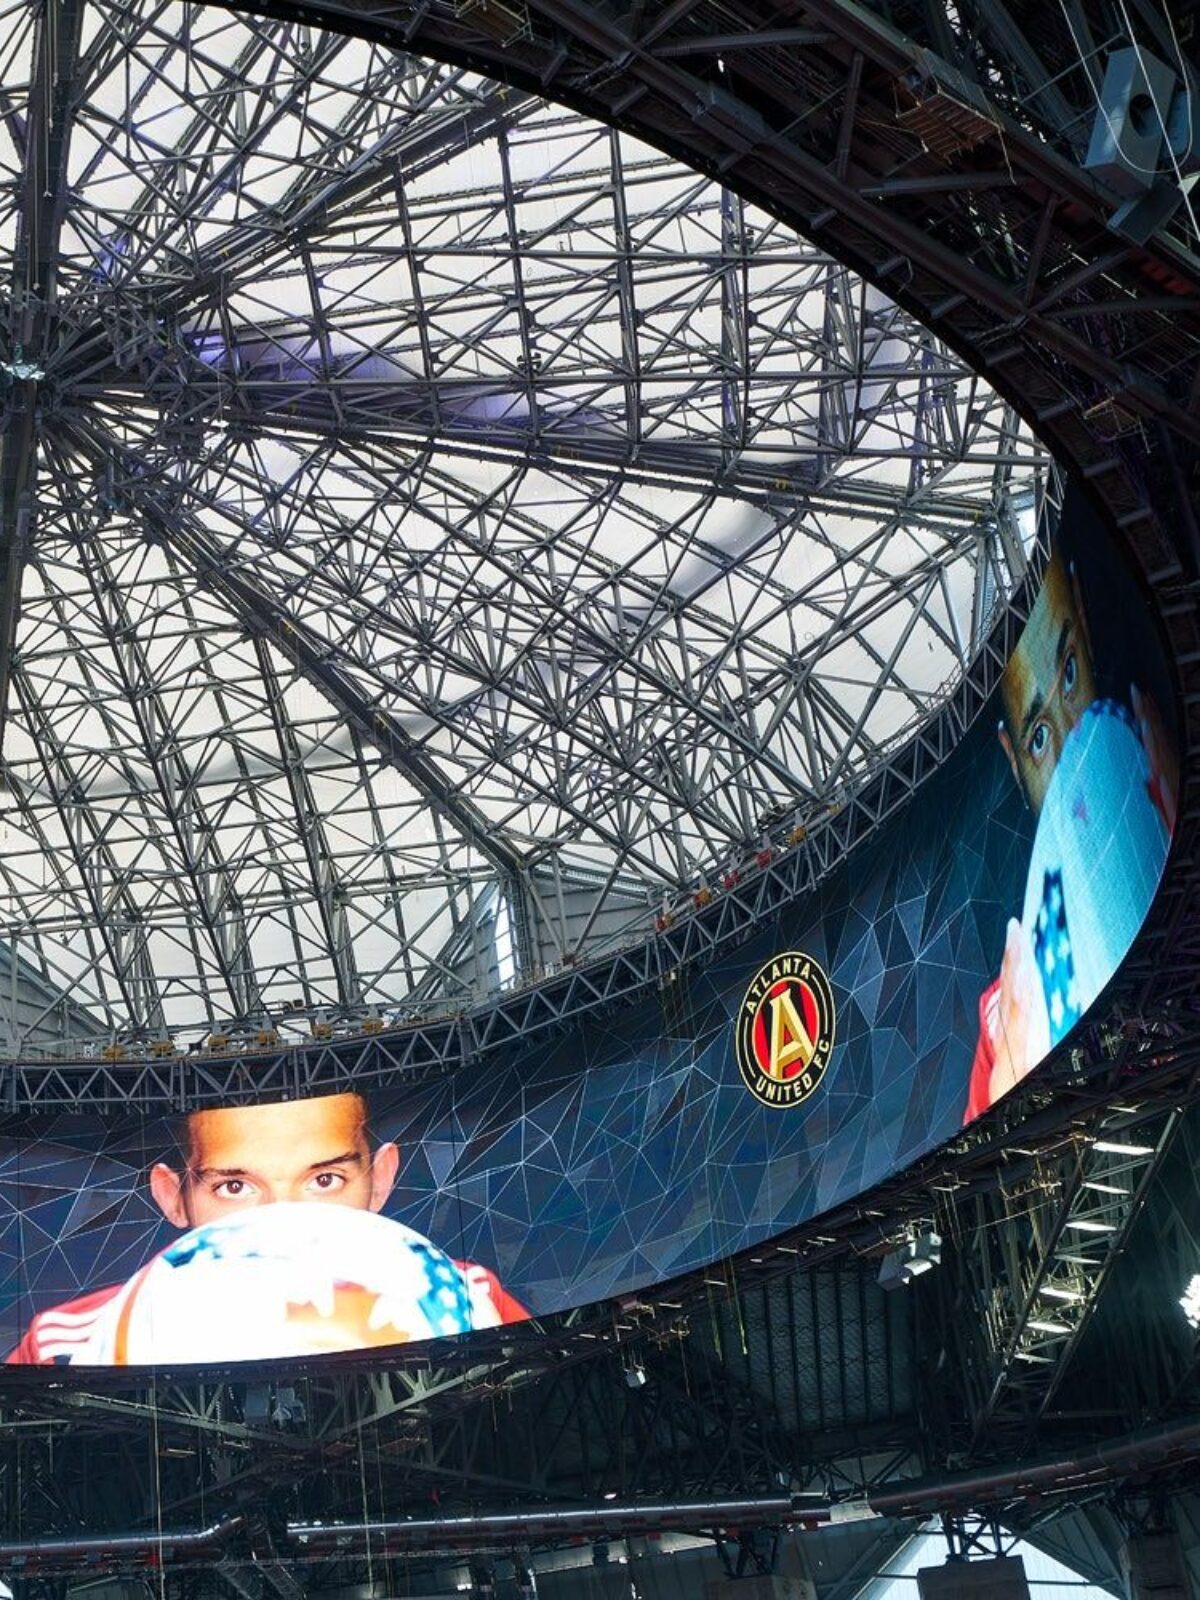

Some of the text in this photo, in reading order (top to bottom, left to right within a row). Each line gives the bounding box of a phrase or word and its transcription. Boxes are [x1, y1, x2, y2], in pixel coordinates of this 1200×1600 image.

[746, 958, 811, 1015] ATLANTA
[769, 988, 815, 1080] A
[755, 1039, 830, 1101] UNITED FC
